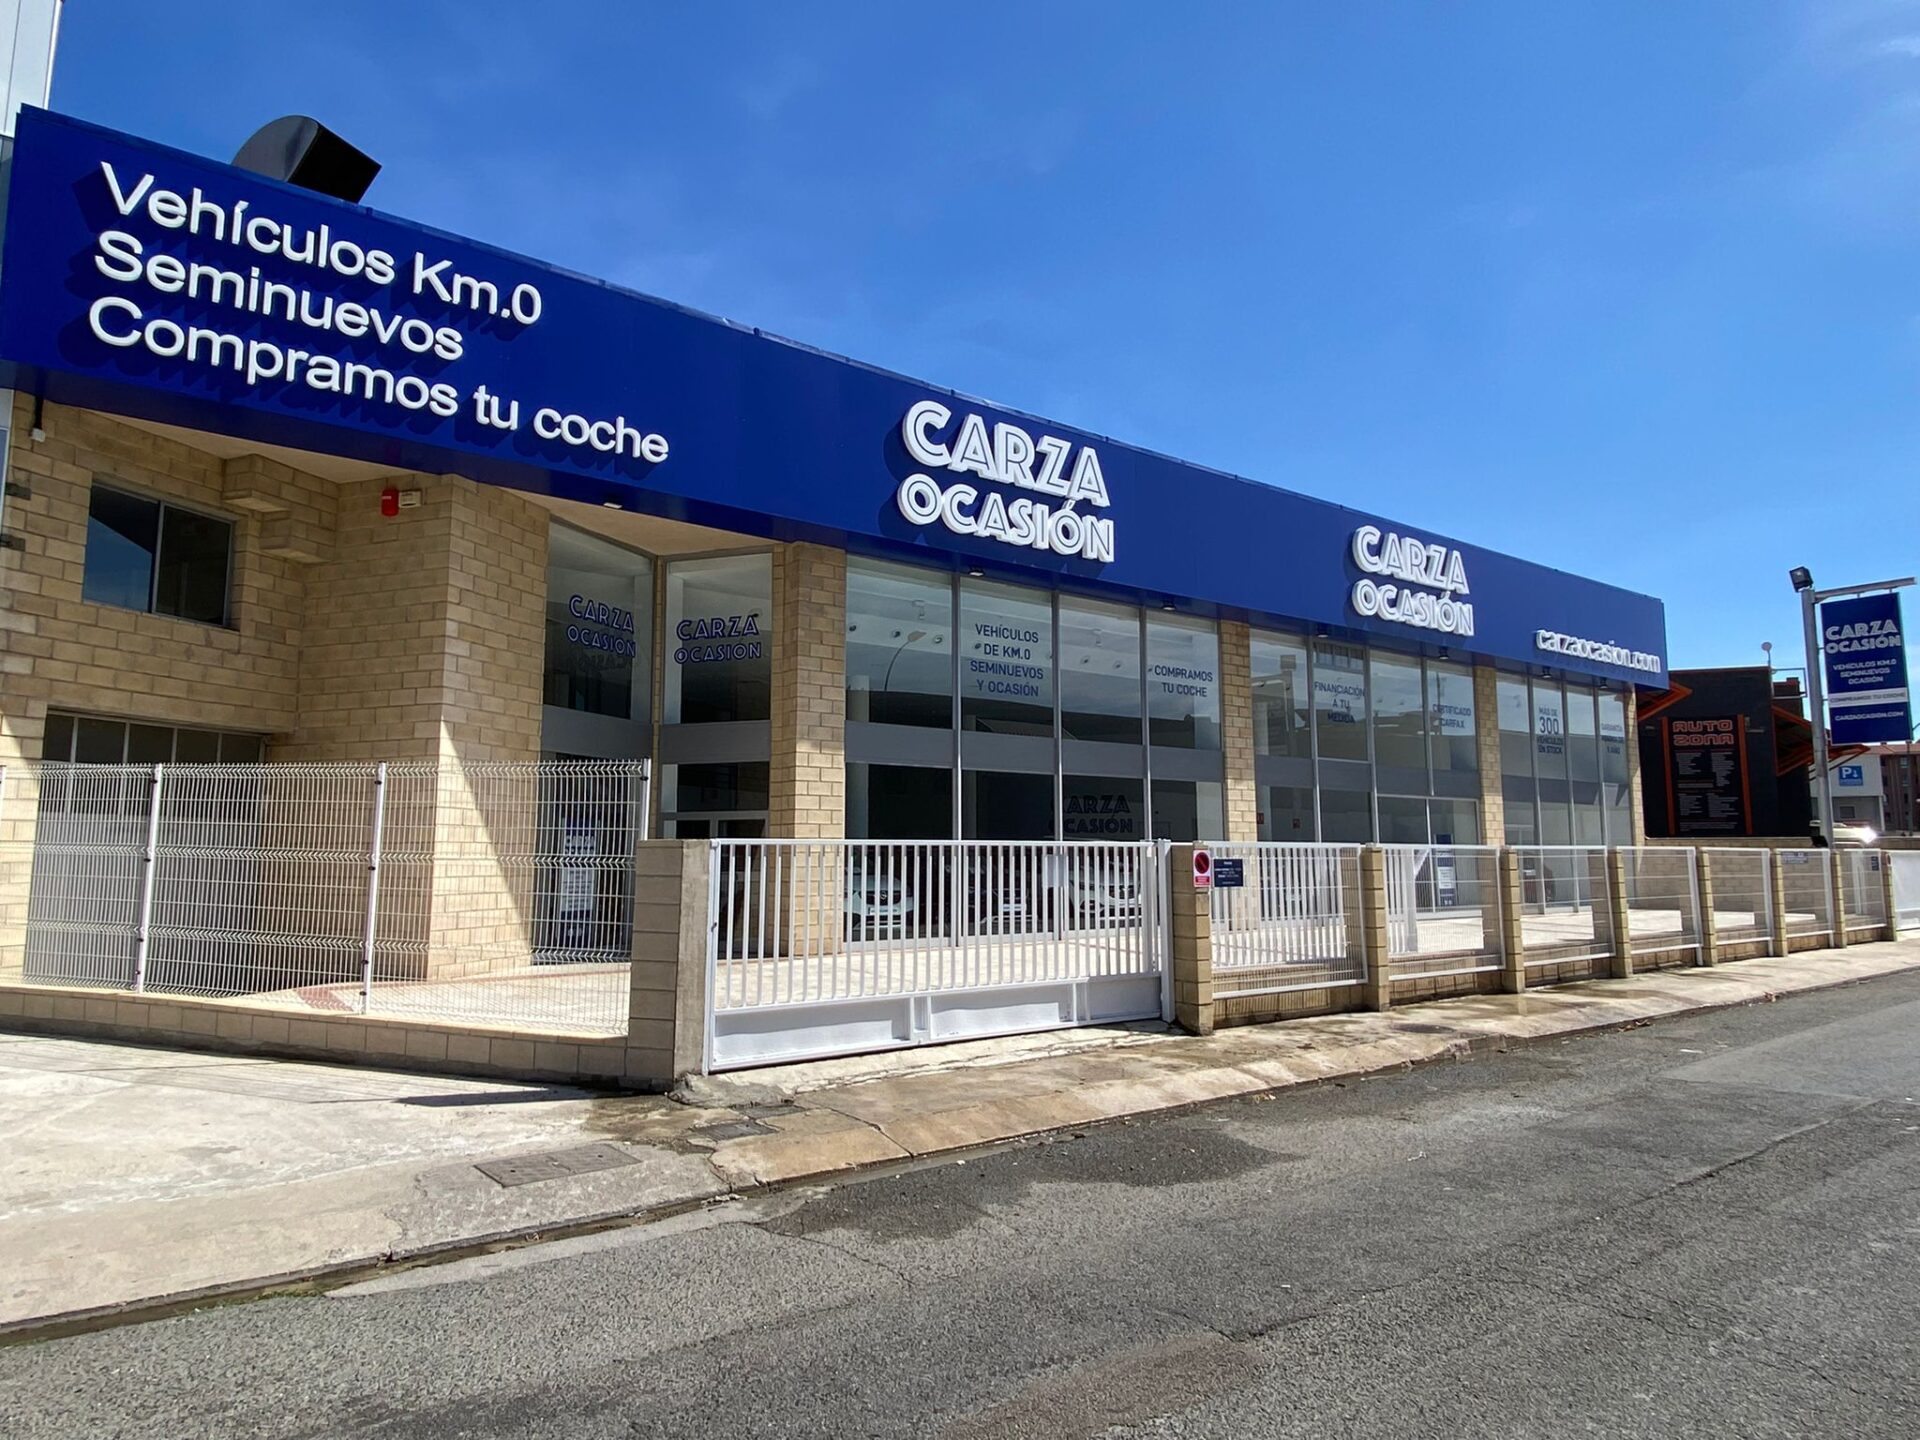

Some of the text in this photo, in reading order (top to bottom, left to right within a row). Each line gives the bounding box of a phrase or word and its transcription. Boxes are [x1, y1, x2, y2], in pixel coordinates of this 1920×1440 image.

[100, 161, 542, 325] Vehículos Km.0
[95, 230, 463, 360] Seminuevos
[89, 296, 669, 464] Compramos tu coche
[902, 400, 1110, 507] CARZA
[897, 473, 1114, 563] OCASIÓN
[1353, 525, 1469, 594] CARZA
[569, 595, 635, 634] CARZA
[1352, 579, 1474, 636] OCASIÓN
[676, 614, 759, 641] CARZA
[975, 623, 1039, 643] VEHÍCULOS
[1826, 619, 1898, 640] CARZA
[983, 643, 1031, 660] DE KM.0
[1825, 634, 1901, 654] OCASIÓN
[970, 660, 1044, 680] SEMINUEVOS
[1154, 665, 1213, 682] COMPRAMOS
[976, 679, 1039, 697] Y OCASIÓN
[1162, 682, 1207, 697] TU COCHE
[1539, 716, 1559, 735] 300
[1672, 719, 1733, 732] AUTO
[1673, 733, 1734, 746] ZONA
[1842, 767, 1852, 779] P
